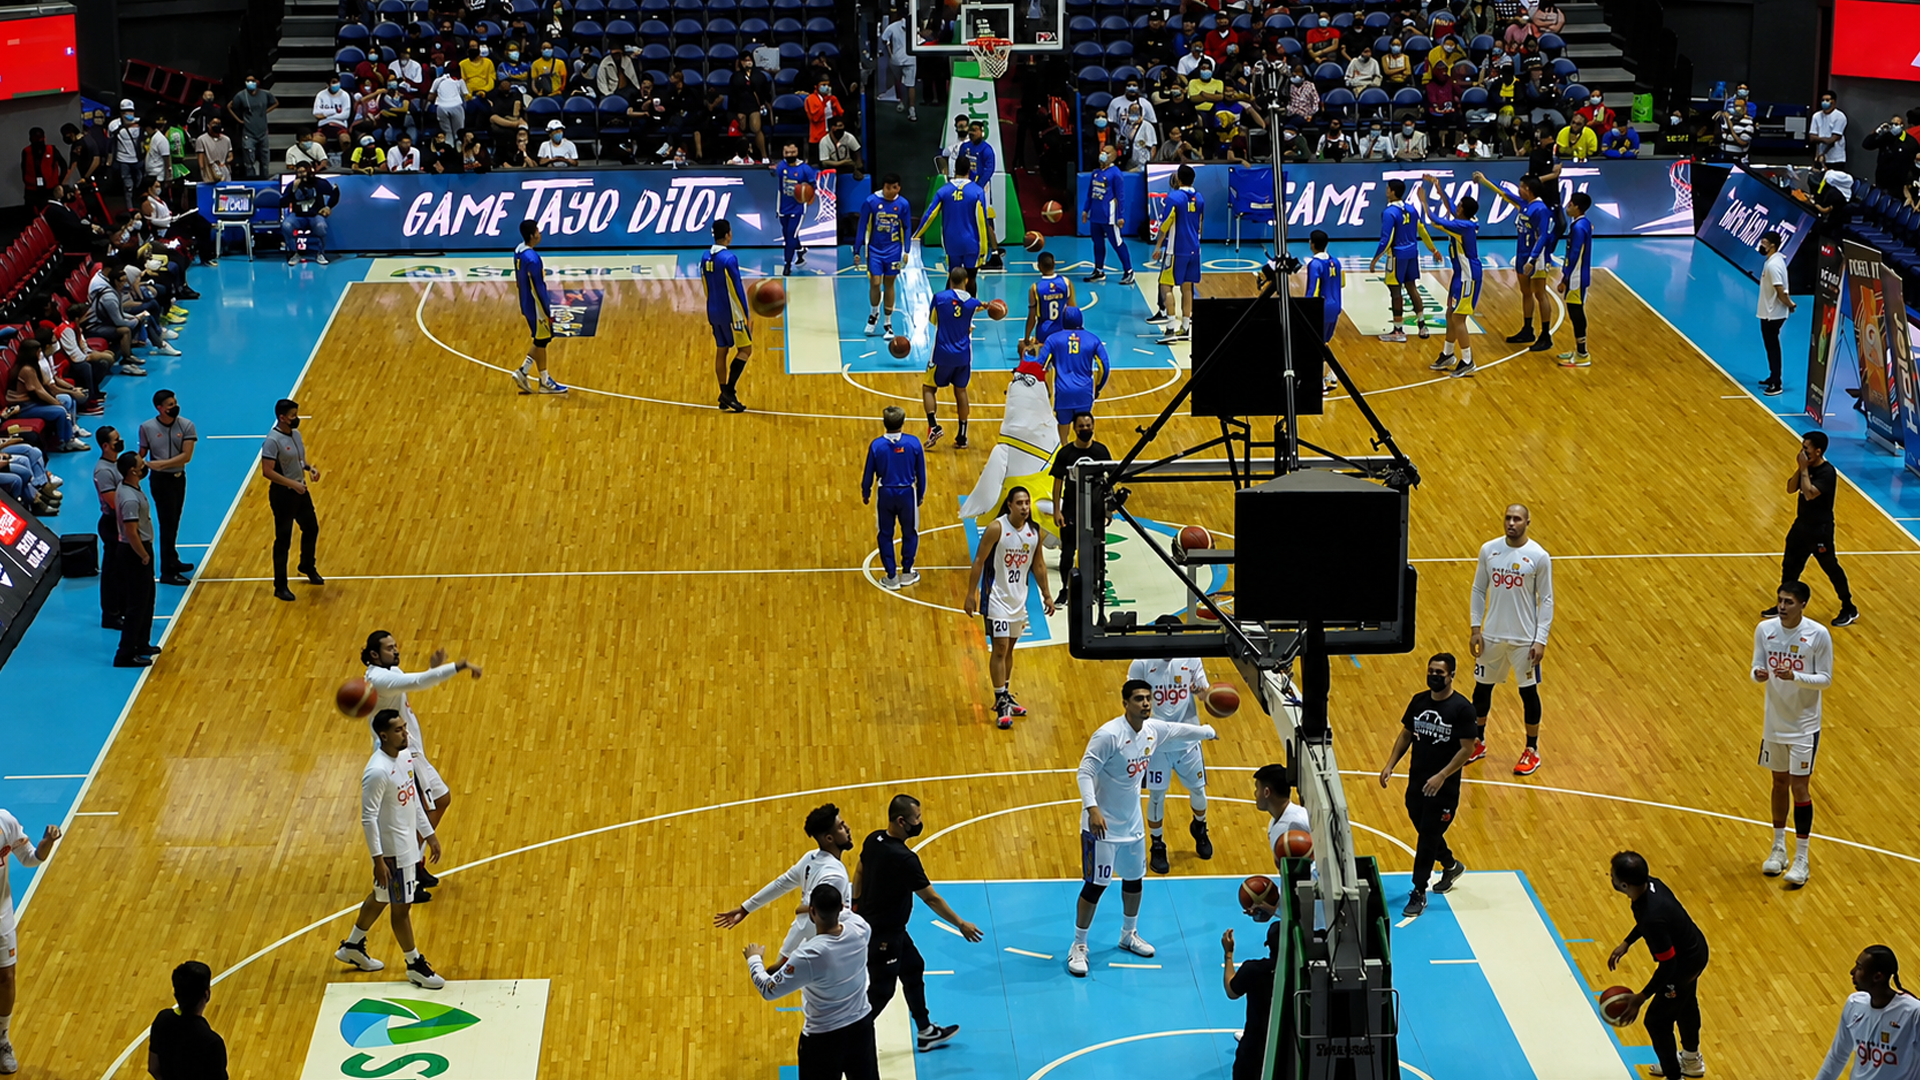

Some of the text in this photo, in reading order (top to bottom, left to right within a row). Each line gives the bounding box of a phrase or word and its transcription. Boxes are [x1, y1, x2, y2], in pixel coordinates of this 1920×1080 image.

[403, 191, 515, 237] GAME
[522, 178, 620, 235] TAYO
[953, 306, 962, 318] 3
[1049, 301, 1059, 321] 6
[1067, 341, 1080, 354] 13
[1008, 569, 1021, 584] 20
[1491, 571, 1524, 590] giga
[994, 620, 1008, 633] 20
[1153, 689, 1188, 706] giga
[1149, 771, 1163, 784] 16
[1098, 864, 1112, 879] 10
[1857, 1042, 1898, 1069] giga
